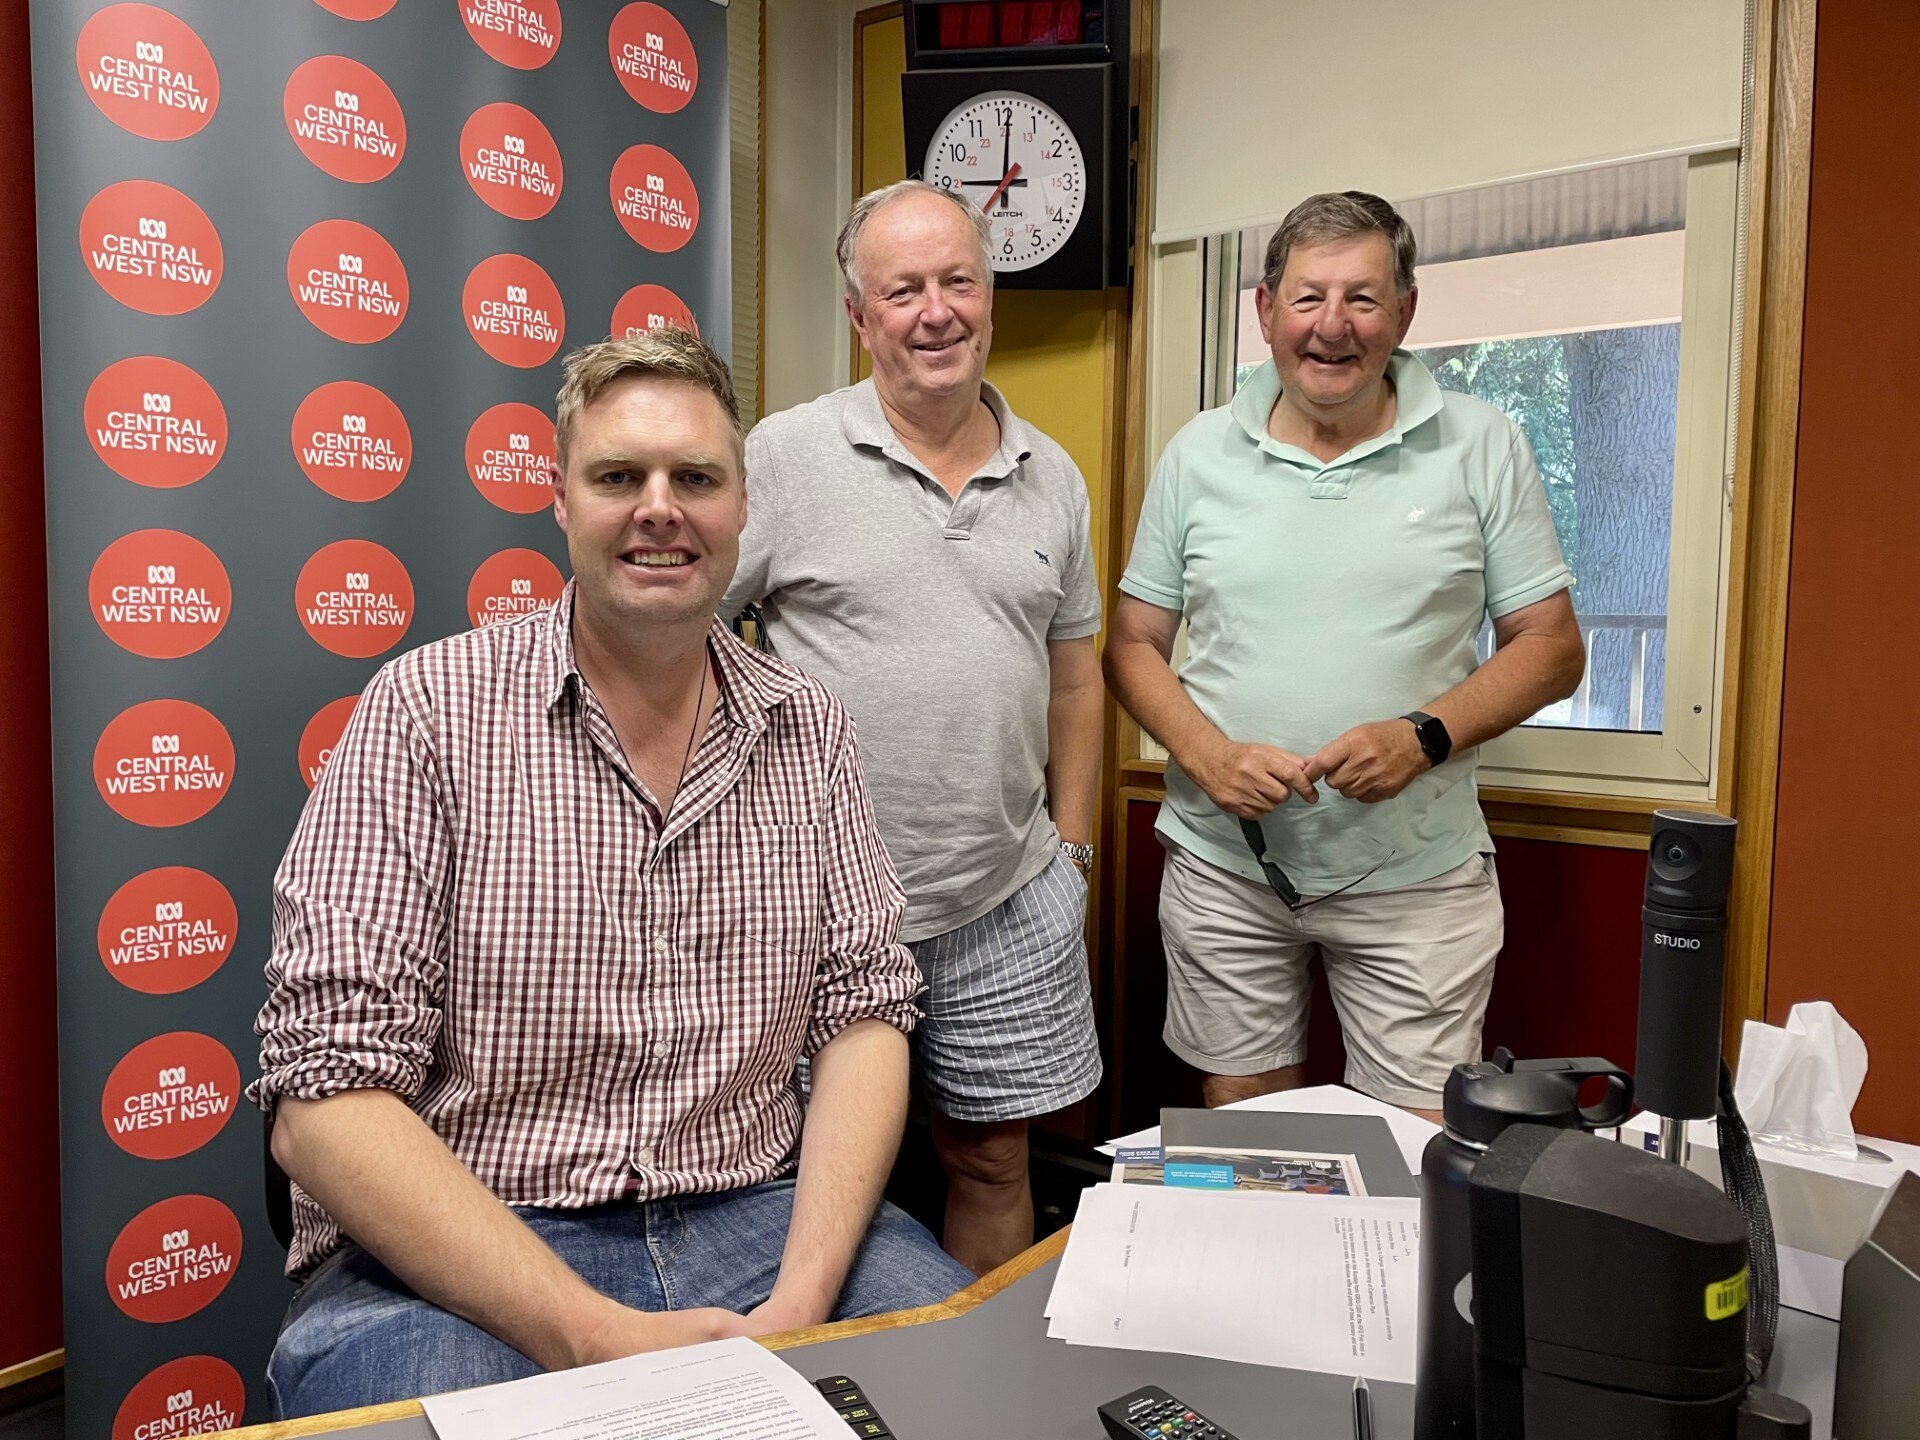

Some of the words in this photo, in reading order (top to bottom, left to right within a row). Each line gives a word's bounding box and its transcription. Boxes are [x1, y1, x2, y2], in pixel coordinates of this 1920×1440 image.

[466, 7, 515, 35] WEST
[517, 22, 554, 49] NSW
[474, 0, 547, 31] CENTRAL
[623, 43, 685, 76] CENTRAL
[98, 54, 200, 94] CENTRAL
[616, 55, 657, 81] WEST
[659, 69, 691, 92] NSW
[88, 70, 154, 102] WEST
[157, 85, 209, 114] NSW
[303, 103, 389, 140] CENTRAL
[969, 119, 982, 138] 11
[995, 107, 1013, 126] 12
[1031, 116, 1036, 134] 1
[294, 118, 350, 146] WEST
[353, 132, 397, 158] NSW
[980, 139, 991, 148] 23
[1023, 133, 1033, 142] 13
[1052, 139, 1062, 157] 2
[477, 147, 549, 180] CENTRAL
[949, 143, 966, 162] 10
[967, 156, 977, 166] 22
[1041, 150, 1050, 160] 14
[468, 162, 518, 186] WEST
[520, 173, 556, 197] NSW
[942, 176, 951, 190] 9
[1052, 177, 1062, 187] 15
[1063, 173, 1073, 191] 3
[624, 186, 686, 215] CENTRAL
[1045, 205, 1055, 215] 16
[618, 199, 658, 222] WEST
[660, 209, 692, 230] NSW
[1052, 207, 1063, 224] 4
[1004, 228, 1014, 237] 18
[1026, 224, 1035, 233] 17
[1031, 229, 1041, 246] 5
[102, 233, 203, 267] CENTRAL
[1003, 238, 1013, 254] 6
[92, 250, 157, 277] WEST
[161, 261, 213, 286] NSW
[307, 268, 393, 299] CENTRAL
[298, 284, 354, 309] WEST
[357, 294, 401, 317] NSW
[480, 300, 552, 327] CENTRAL
[471, 314, 520, 336] WEST
[523, 322, 558, 343] NSW
[106, 411, 208, 438] CENTRAL
[96, 428, 162, 451] WEST
[165, 434, 217, 457] NSW
[311, 431, 396, 455] CENTRAL
[303, 447, 358, 468] WEST
[361, 453, 404, 473] NSW
[474, 464, 523, 483] WEST
[111, 585, 212, 605] CENTRAL
[315, 591, 398, 609] CENTRAL
[101, 604, 166, 623] WEST
[170, 605, 221, 624] NSW
[306, 608, 361, 625] WEST
[364, 609, 406, 626] NSW
[116, 754, 215, 776] CENTRAL
[106, 774, 169, 795] WEST
[174, 771, 224, 791] NSW
[120, 918, 218, 945] CENTRAL
[1654, 933, 1701, 950] STUDIO
[109, 941, 173, 965] WEST
[177, 934, 227, 957] NSW
[124, 1081, 220, 1113] CENTRAL
[113, 1106, 176, 1133] WEST
[180, 1096, 229, 1121] NSW
[128, 1242, 222, 1279] CENTRAL
[118, 1269, 179, 1299] WEST
[184, 1255, 231, 1283] NSW
[134, 1400, 226, 1440] CENTRAL
